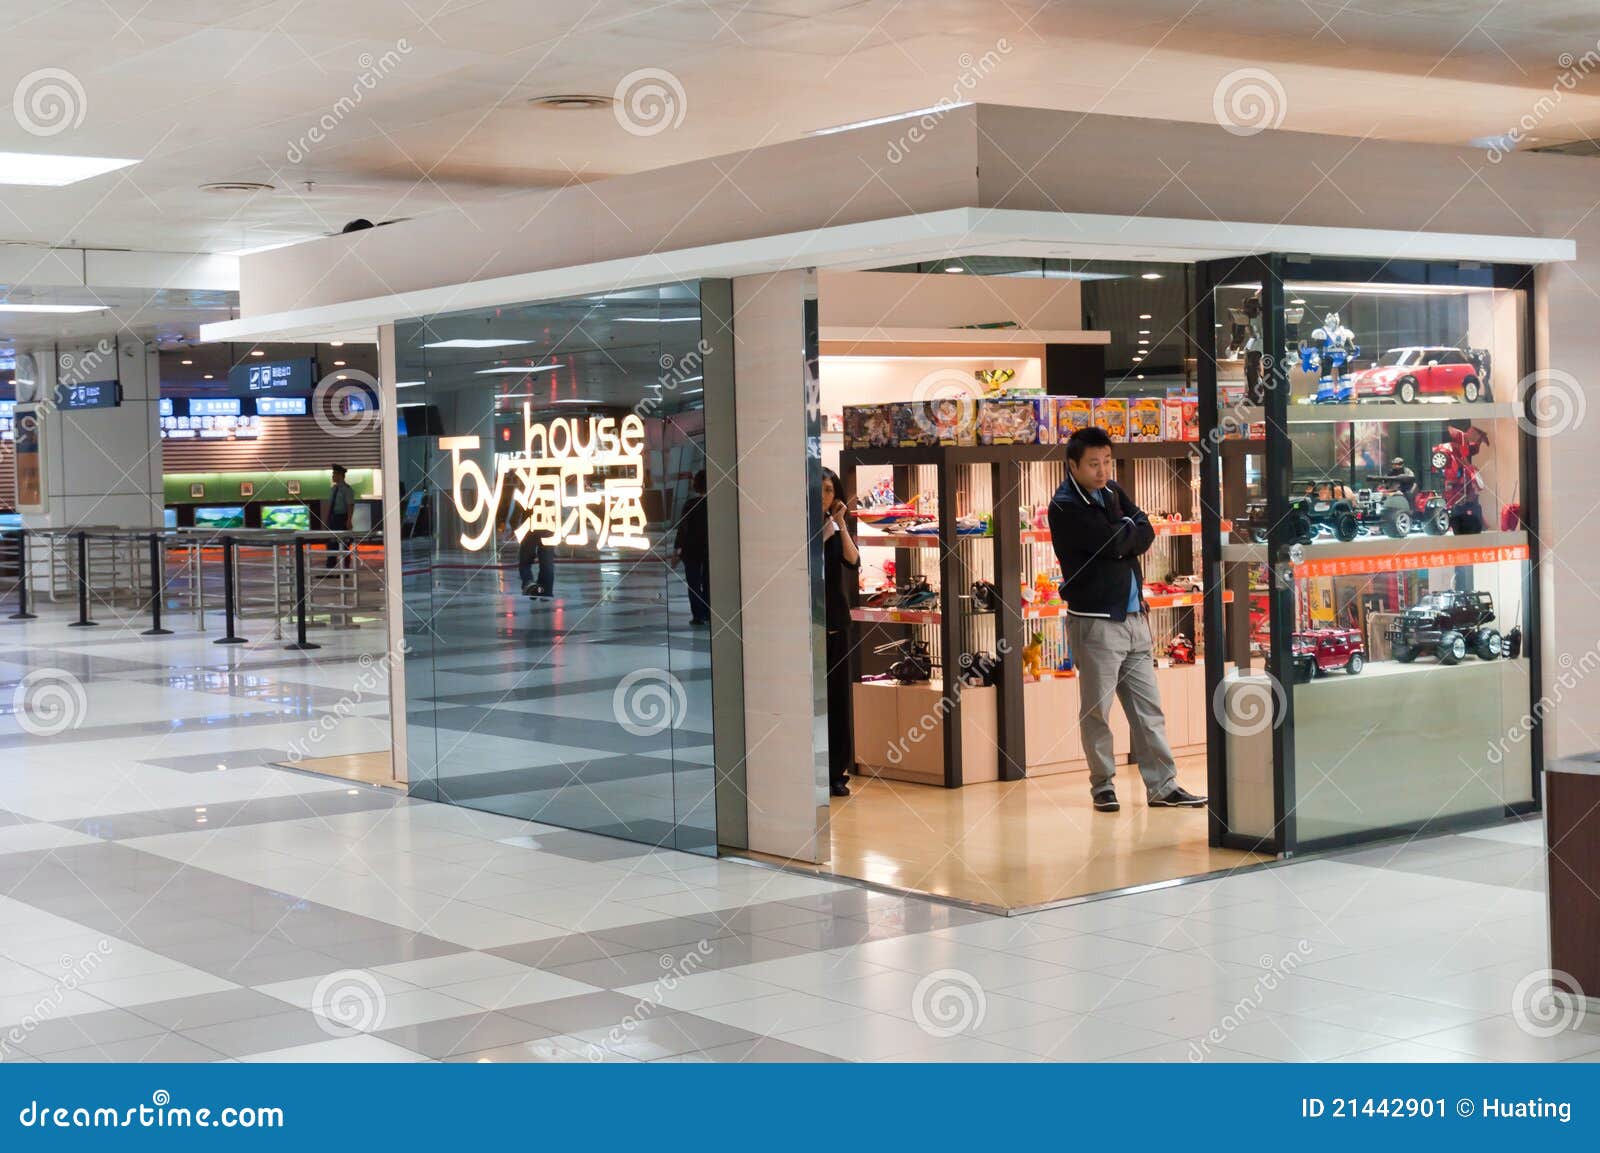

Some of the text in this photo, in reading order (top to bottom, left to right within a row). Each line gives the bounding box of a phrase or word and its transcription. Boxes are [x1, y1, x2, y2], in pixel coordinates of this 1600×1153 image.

[523, 401, 645, 459] house
[512, 456, 651, 551] 淘乐屋
